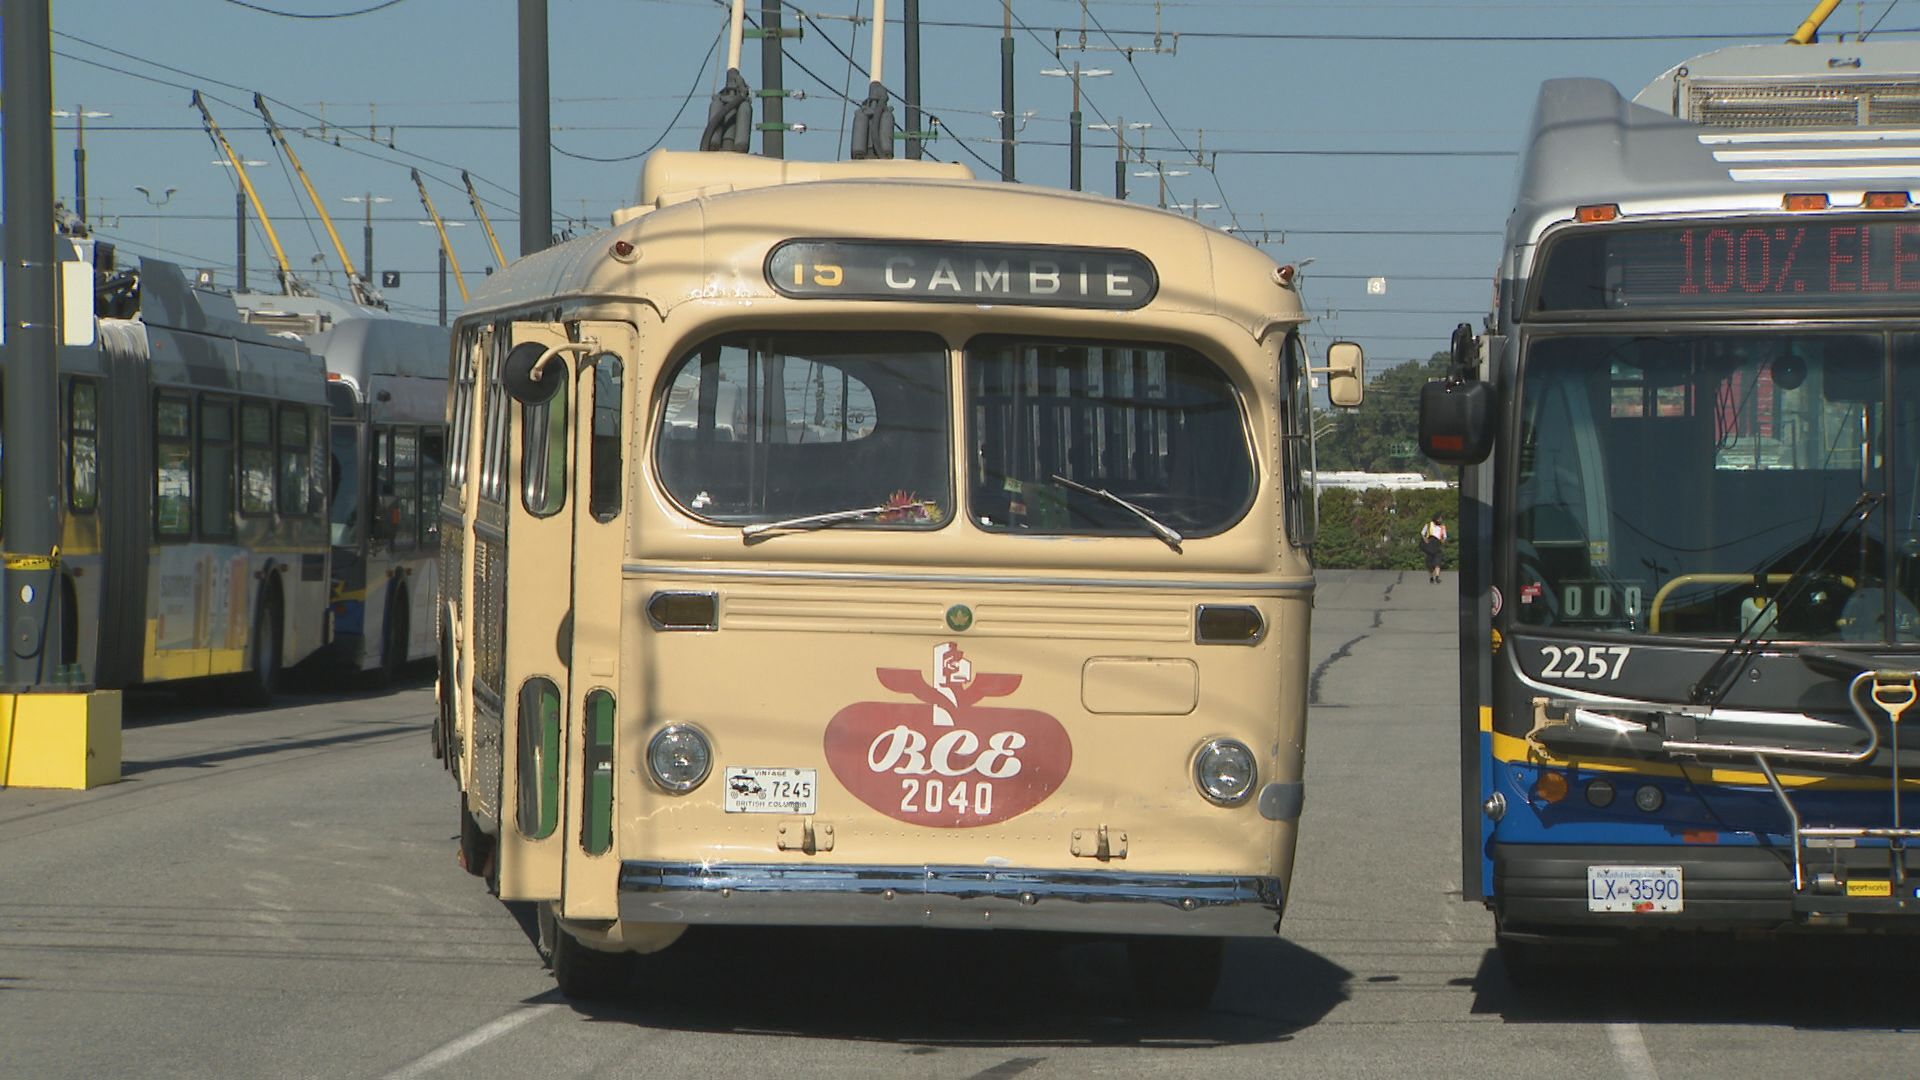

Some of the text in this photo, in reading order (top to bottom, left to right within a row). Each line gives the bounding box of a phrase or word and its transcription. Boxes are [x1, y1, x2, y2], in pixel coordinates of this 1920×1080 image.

[794, 256, 1134, 297] 15 CAMBIE
[1680, 228, 1805, 294] 100%
[1541, 645, 1631, 681] 2257
[868, 725, 1026, 779] BCE
[772, 781, 811, 798] 7245
[901, 778, 993, 815] 2040
[1592, 879, 1679, 900] LX 3590
